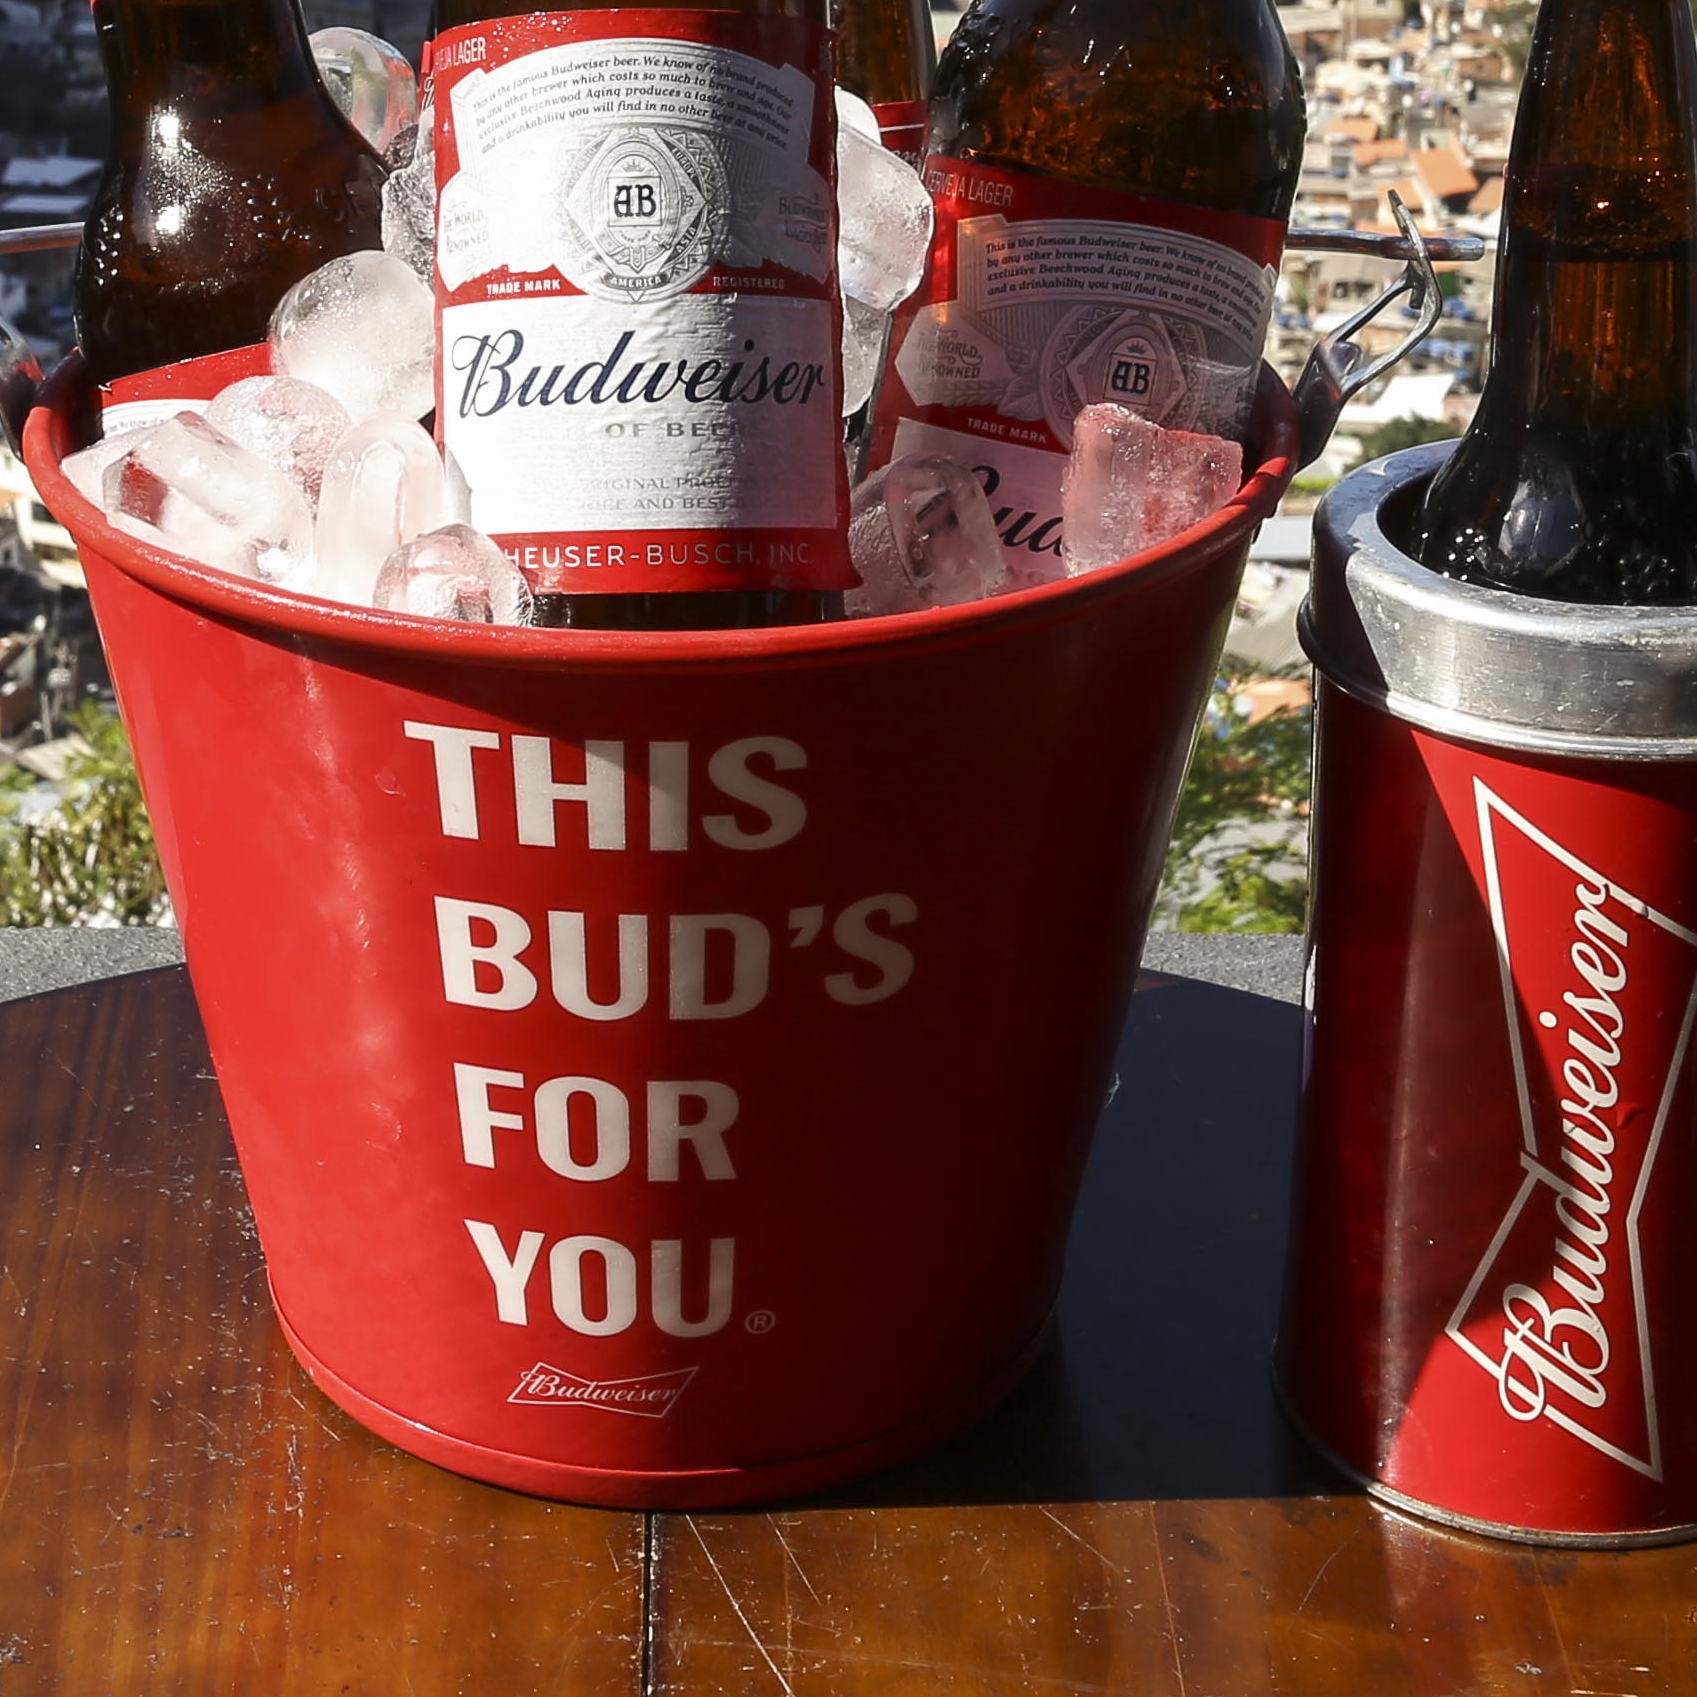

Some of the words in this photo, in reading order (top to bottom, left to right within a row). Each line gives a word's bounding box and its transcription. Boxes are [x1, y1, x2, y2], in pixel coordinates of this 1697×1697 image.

[453, 36, 487, 67] LAGER
[613, 184, 658, 217] AB
[968, 177, 1014, 206] LAGER
[676, 227, 697, 253] ASIA
[486, 281, 521, 295] TRADE
[524, 278, 561, 292] MARK
[610, 274, 663, 288] AMERICA
[713, 276, 785, 290] REGISTERED
[936, 340, 979, 358] WORLD
[451, 329, 826, 420] Budweiser
[1111, 360, 1151, 394] AB
[605, 422, 646, 439] OF
[967, 417, 1005, 434] TRADE
[1009, 426, 1047, 444] MARK
[633, 497, 675, 510] AND
[682, 496, 728, 510] BEST
[403, 719, 809, 852] THIS
[433, 892, 920, 1022] BUD'S
[453, 1061, 741, 1183] FOR
[1497, 879, 1648, 1423] Budweiser
[520, 1370, 680, 1402] Budweiser
